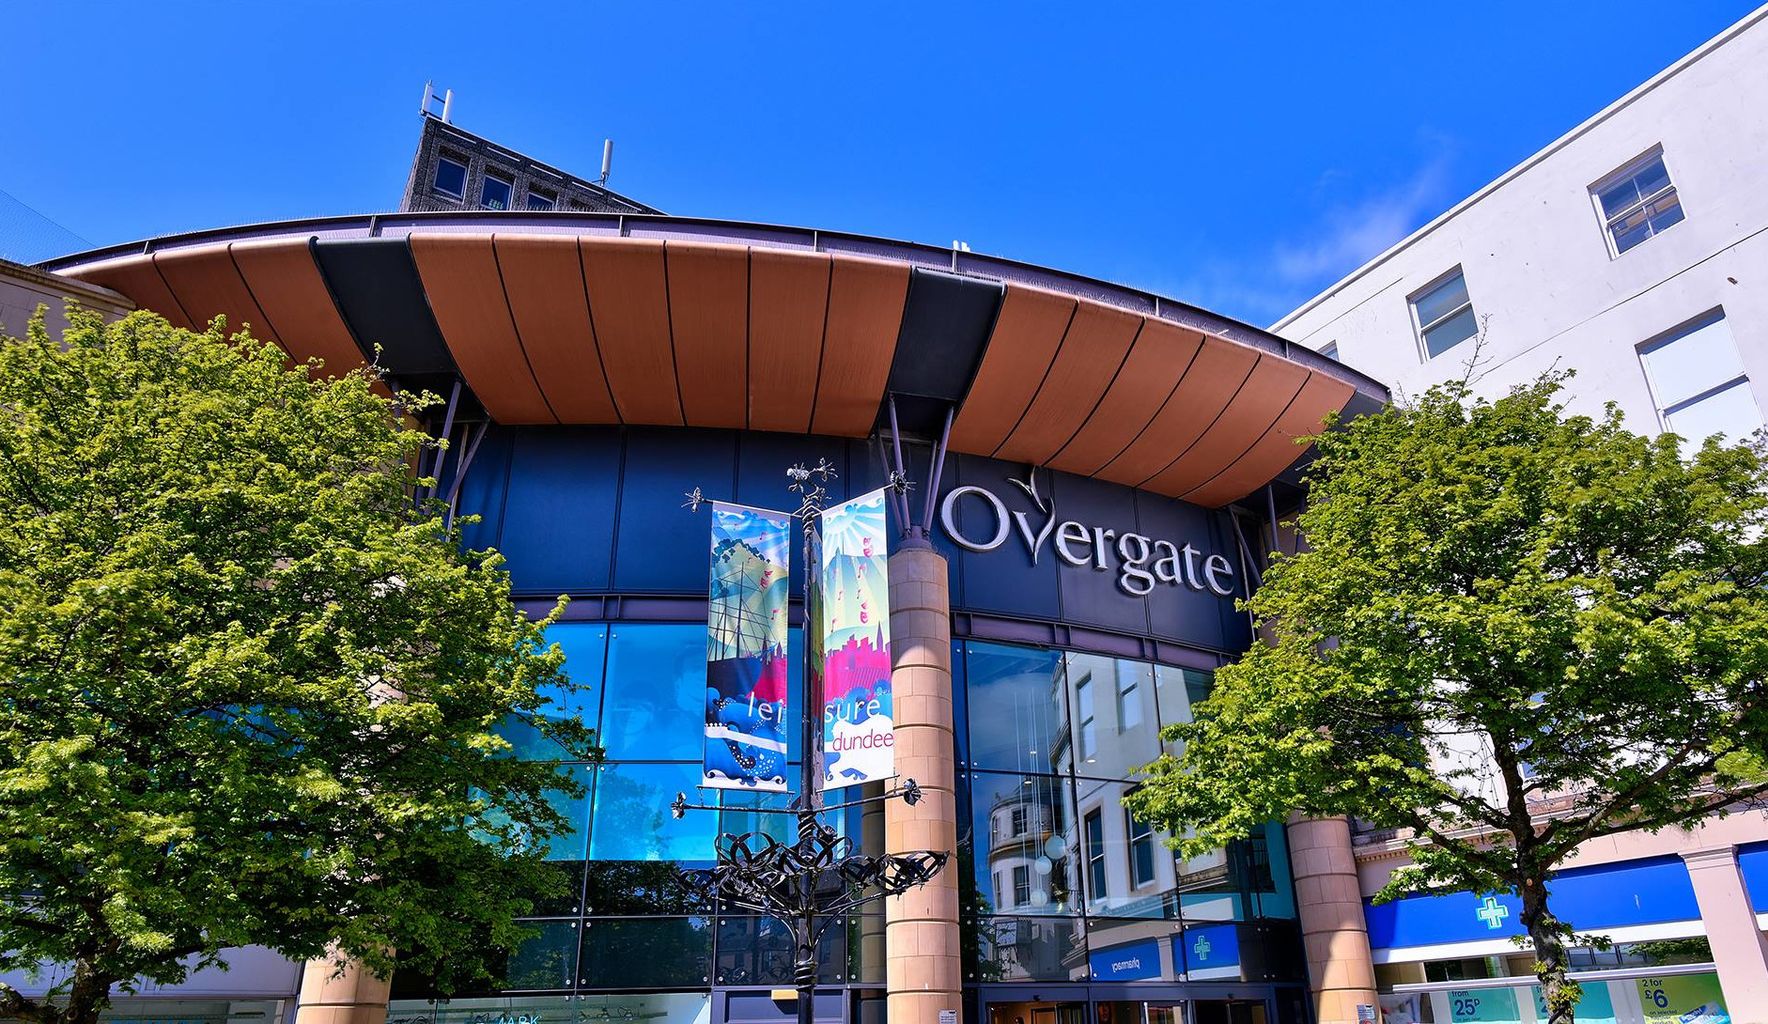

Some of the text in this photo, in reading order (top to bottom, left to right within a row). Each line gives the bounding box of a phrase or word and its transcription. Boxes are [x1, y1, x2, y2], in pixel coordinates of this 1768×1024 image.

[941, 465, 1235, 595] Overgate
[832, 728, 893, 751] dundee
[1642, 979, 1663, 987] 2 for
